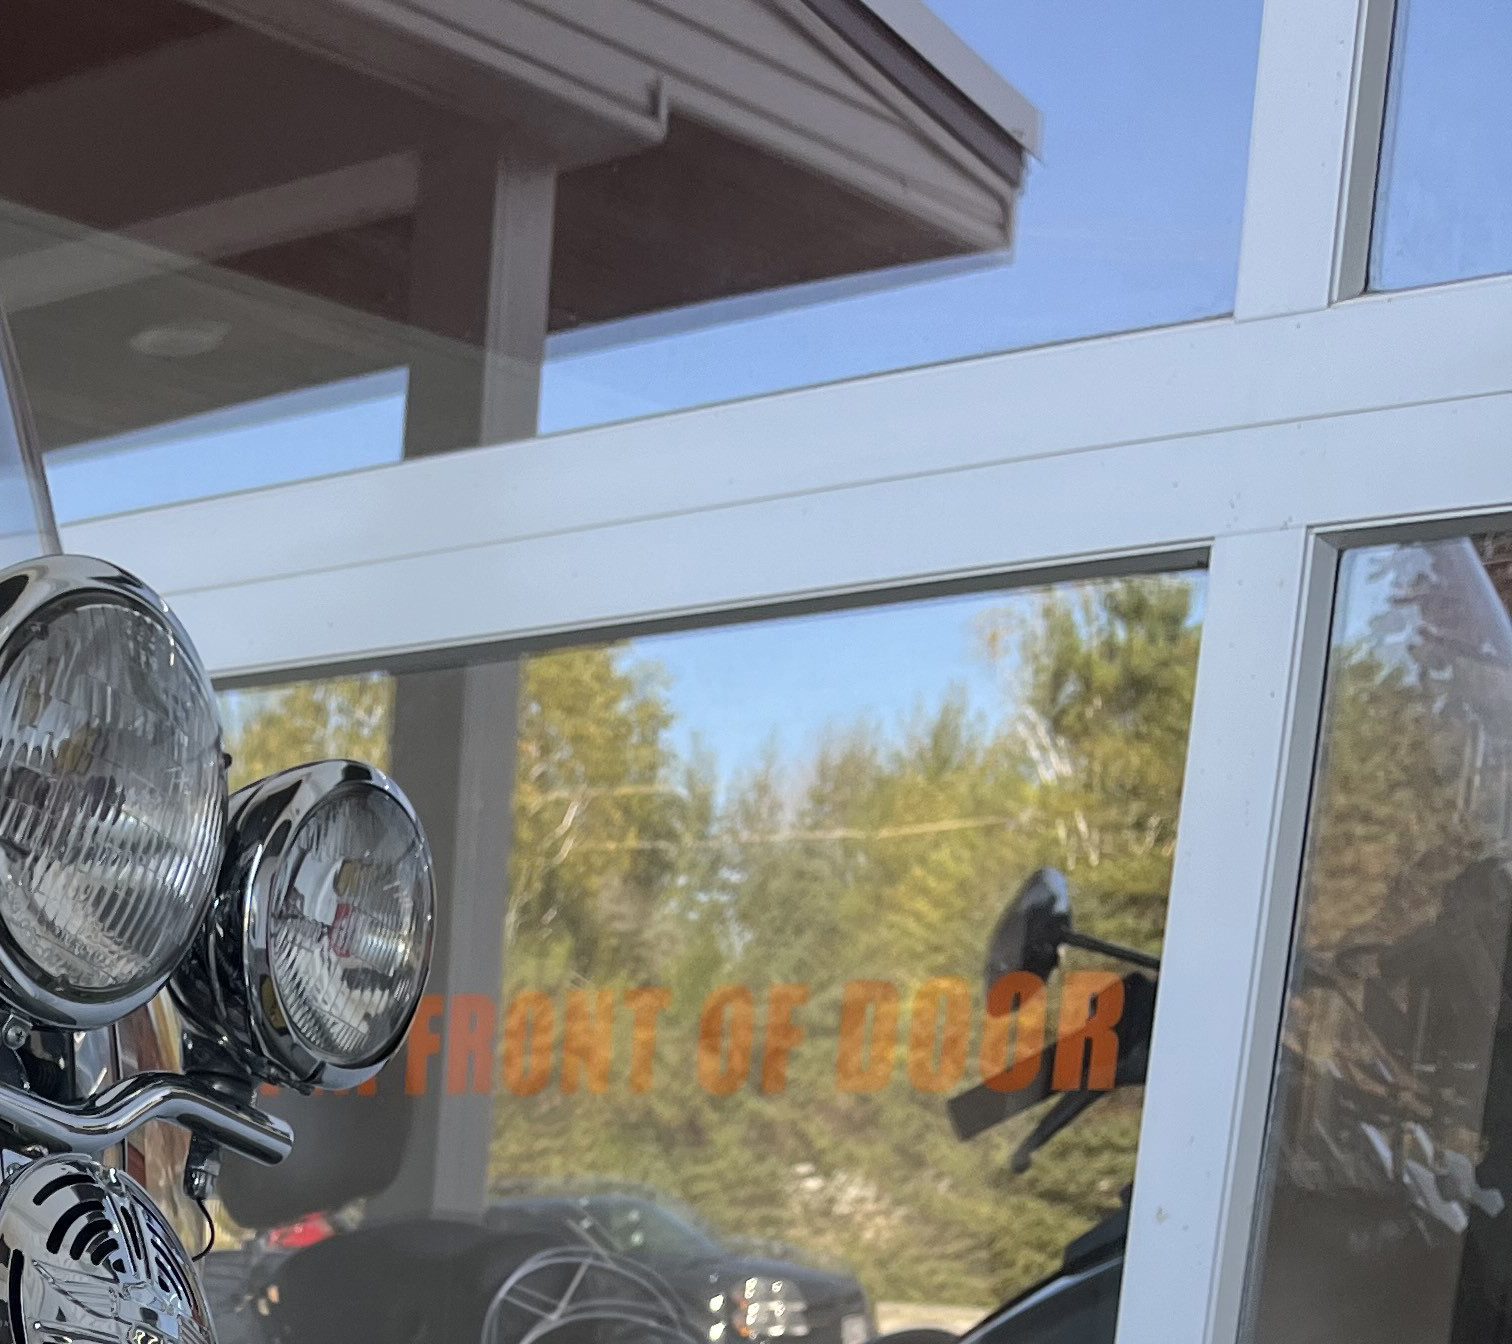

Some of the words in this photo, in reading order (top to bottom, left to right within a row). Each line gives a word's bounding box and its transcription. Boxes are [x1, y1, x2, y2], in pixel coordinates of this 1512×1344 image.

[405, 988, 675, 1098] FRONT
[696, 982, 809, 1097] OF
[835, 971, 1128, 1095] DOOR
